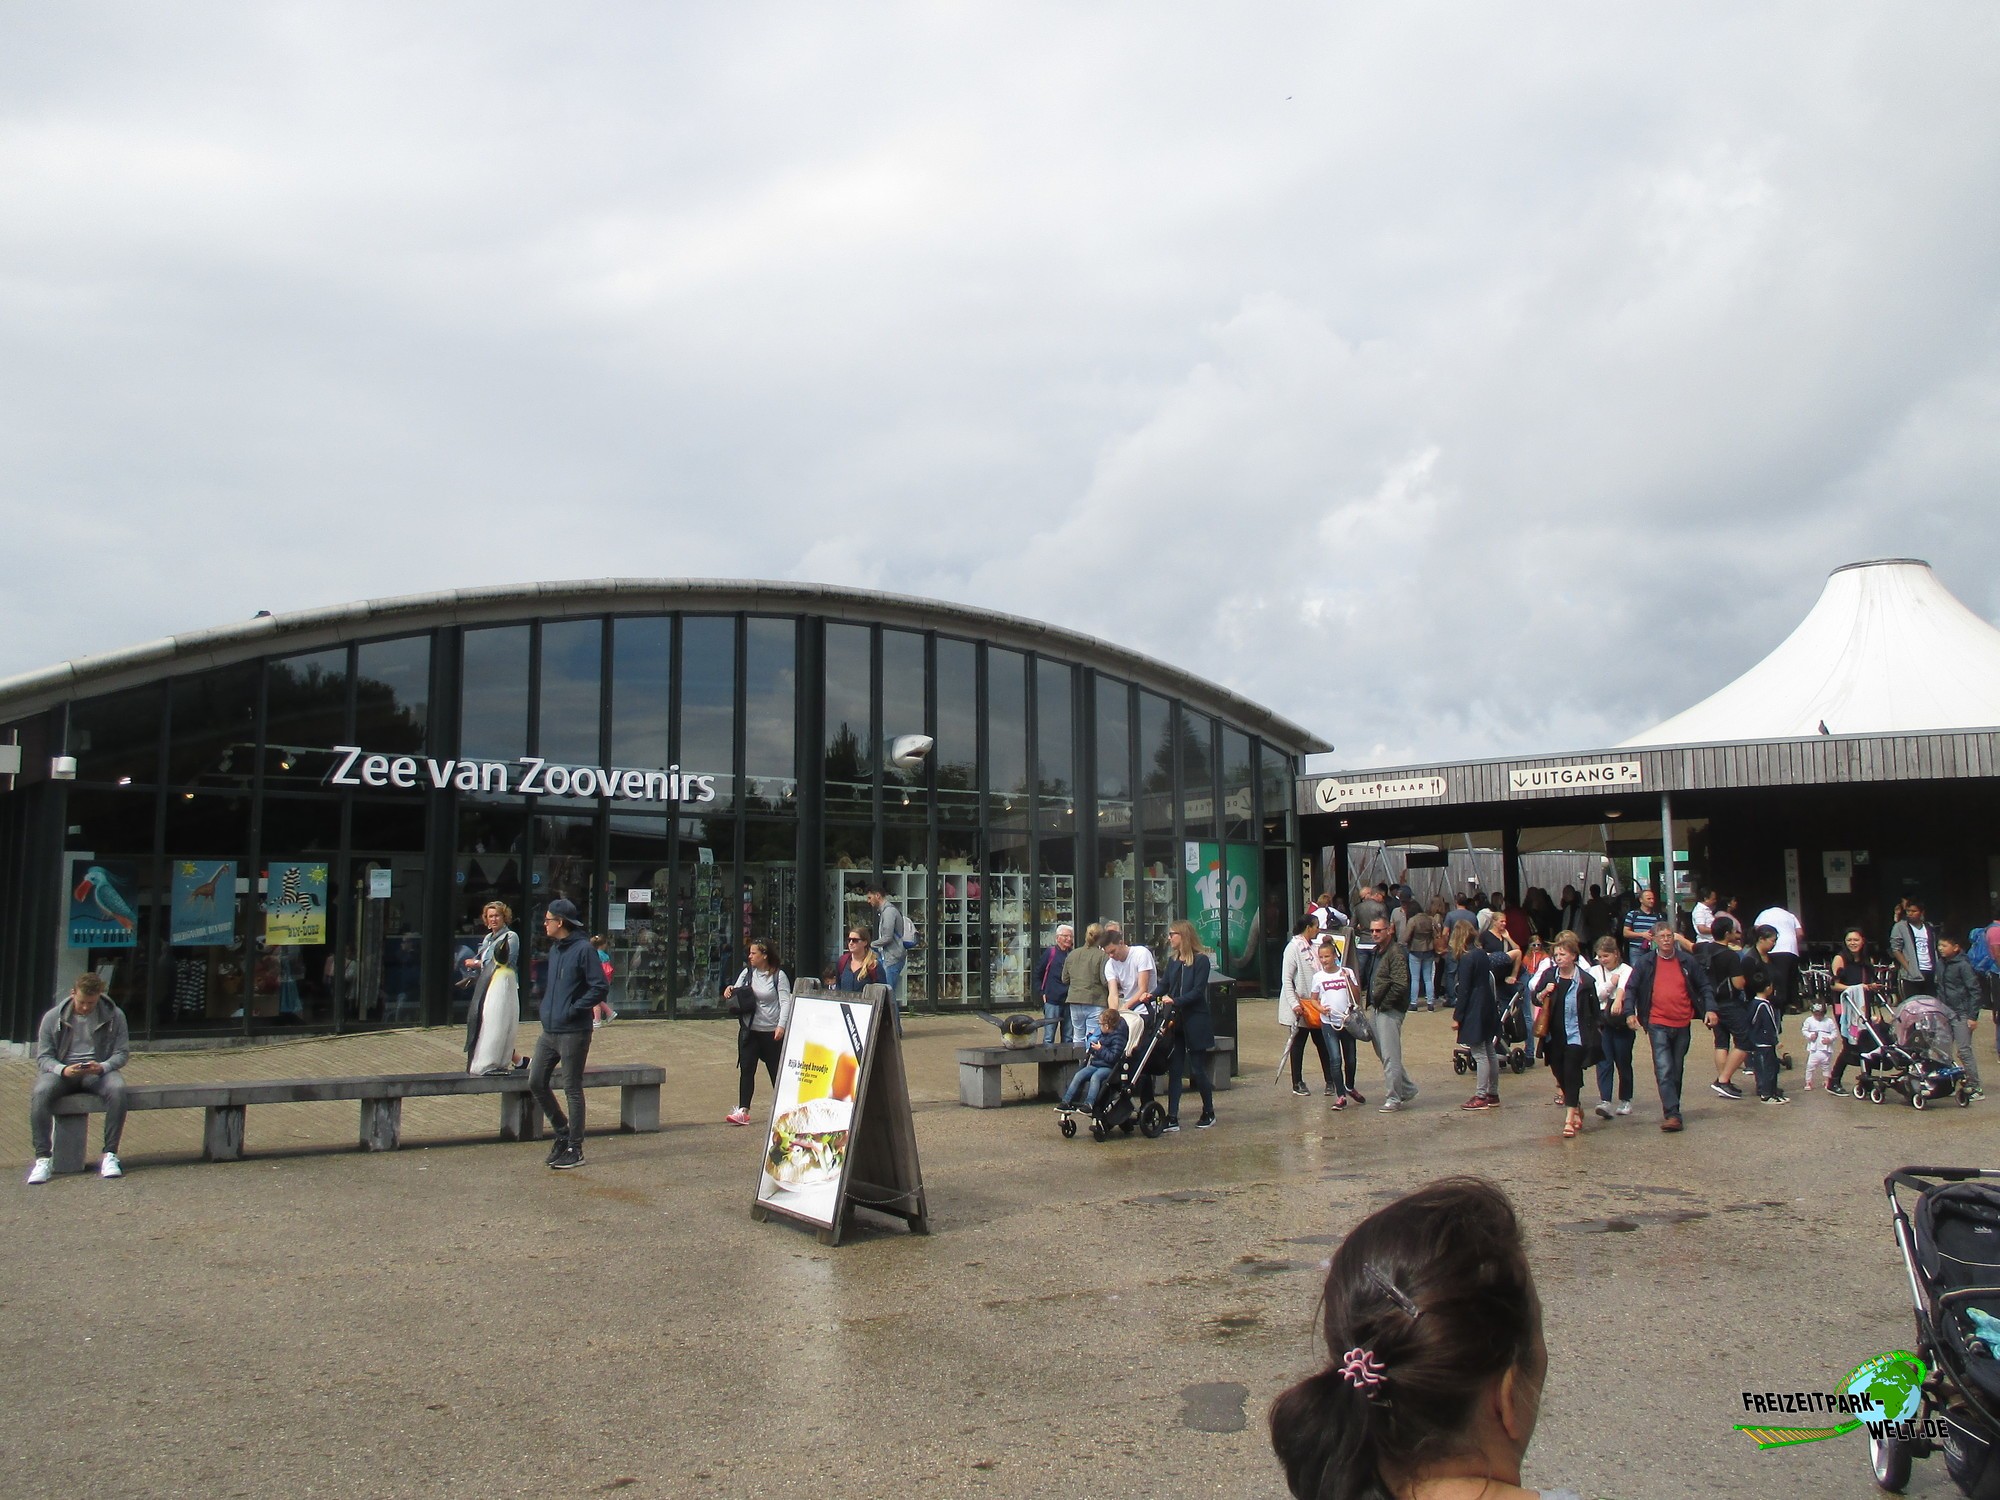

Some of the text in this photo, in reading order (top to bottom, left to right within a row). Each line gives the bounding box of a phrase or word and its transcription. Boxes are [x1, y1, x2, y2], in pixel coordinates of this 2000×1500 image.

[332, 745, 716, 802] Zee van Zoovenirs
[1531, 767, 1614, 785] UITGANG
[1340, 788, 1354, 797] DE
[1210, 909, 1233, 920] JAR
